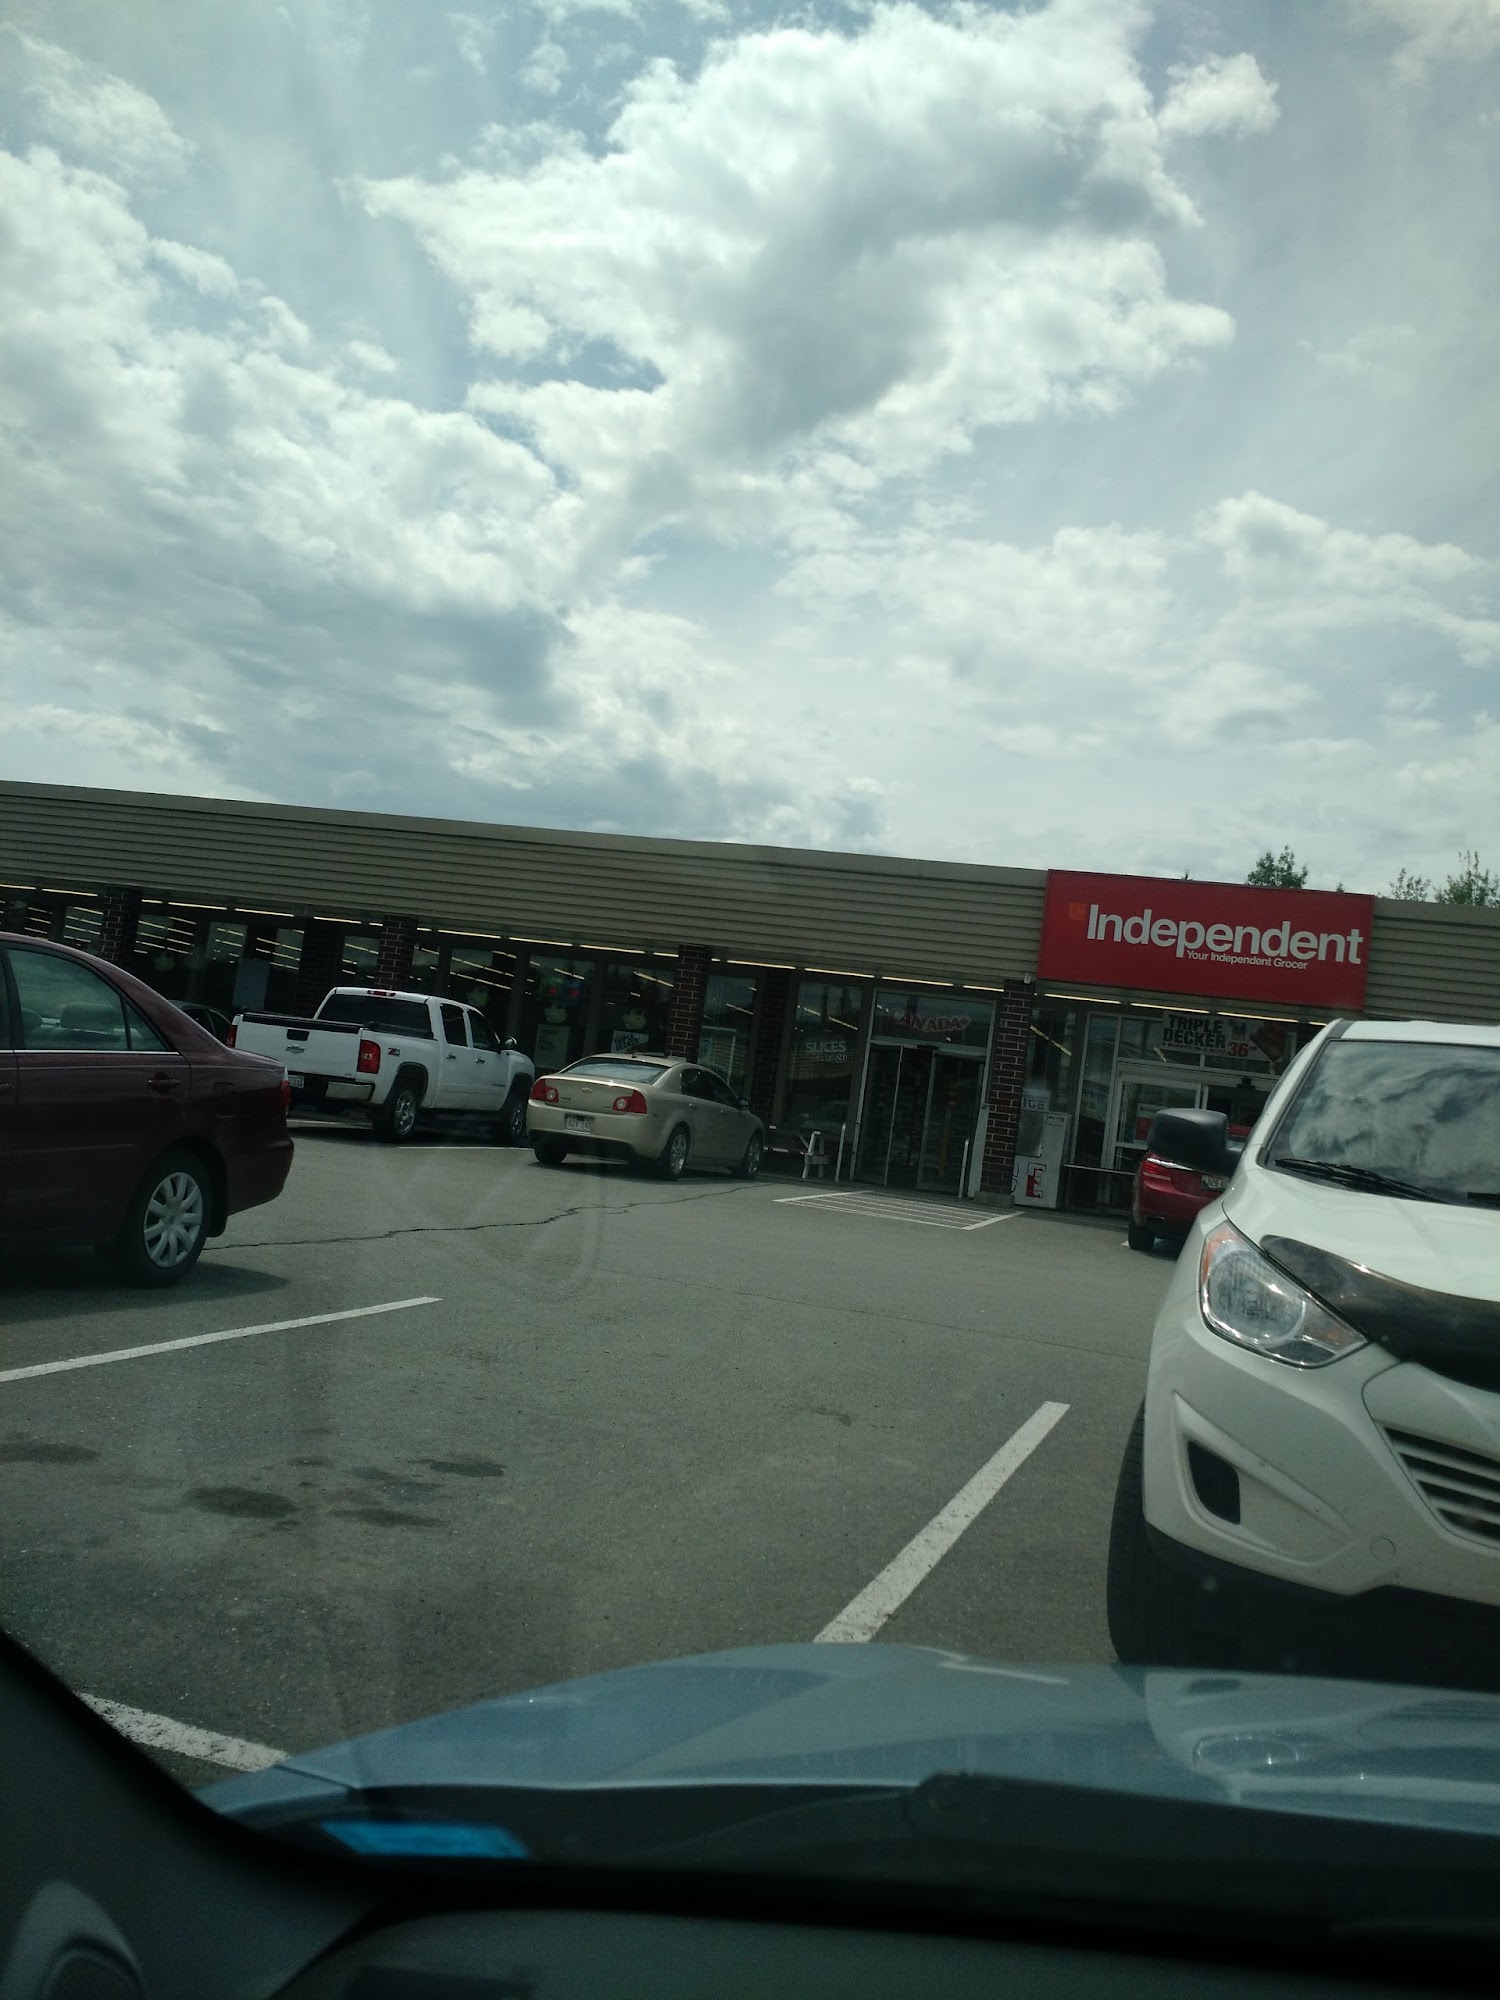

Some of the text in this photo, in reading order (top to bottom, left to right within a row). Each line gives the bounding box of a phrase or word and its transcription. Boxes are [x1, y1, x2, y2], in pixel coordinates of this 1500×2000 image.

[1087, 904, 1364, 965] Independent
[1186, 949, 1308, 970] Your Independent Grocer
[1168, 1014, 1223, 1034] TRIPLE
[1162, 1027, 1226, 1049] DECKER
[1227, 1041, 1249, 1058] 36
[1022, 1098, 1046, 1110] ICE
